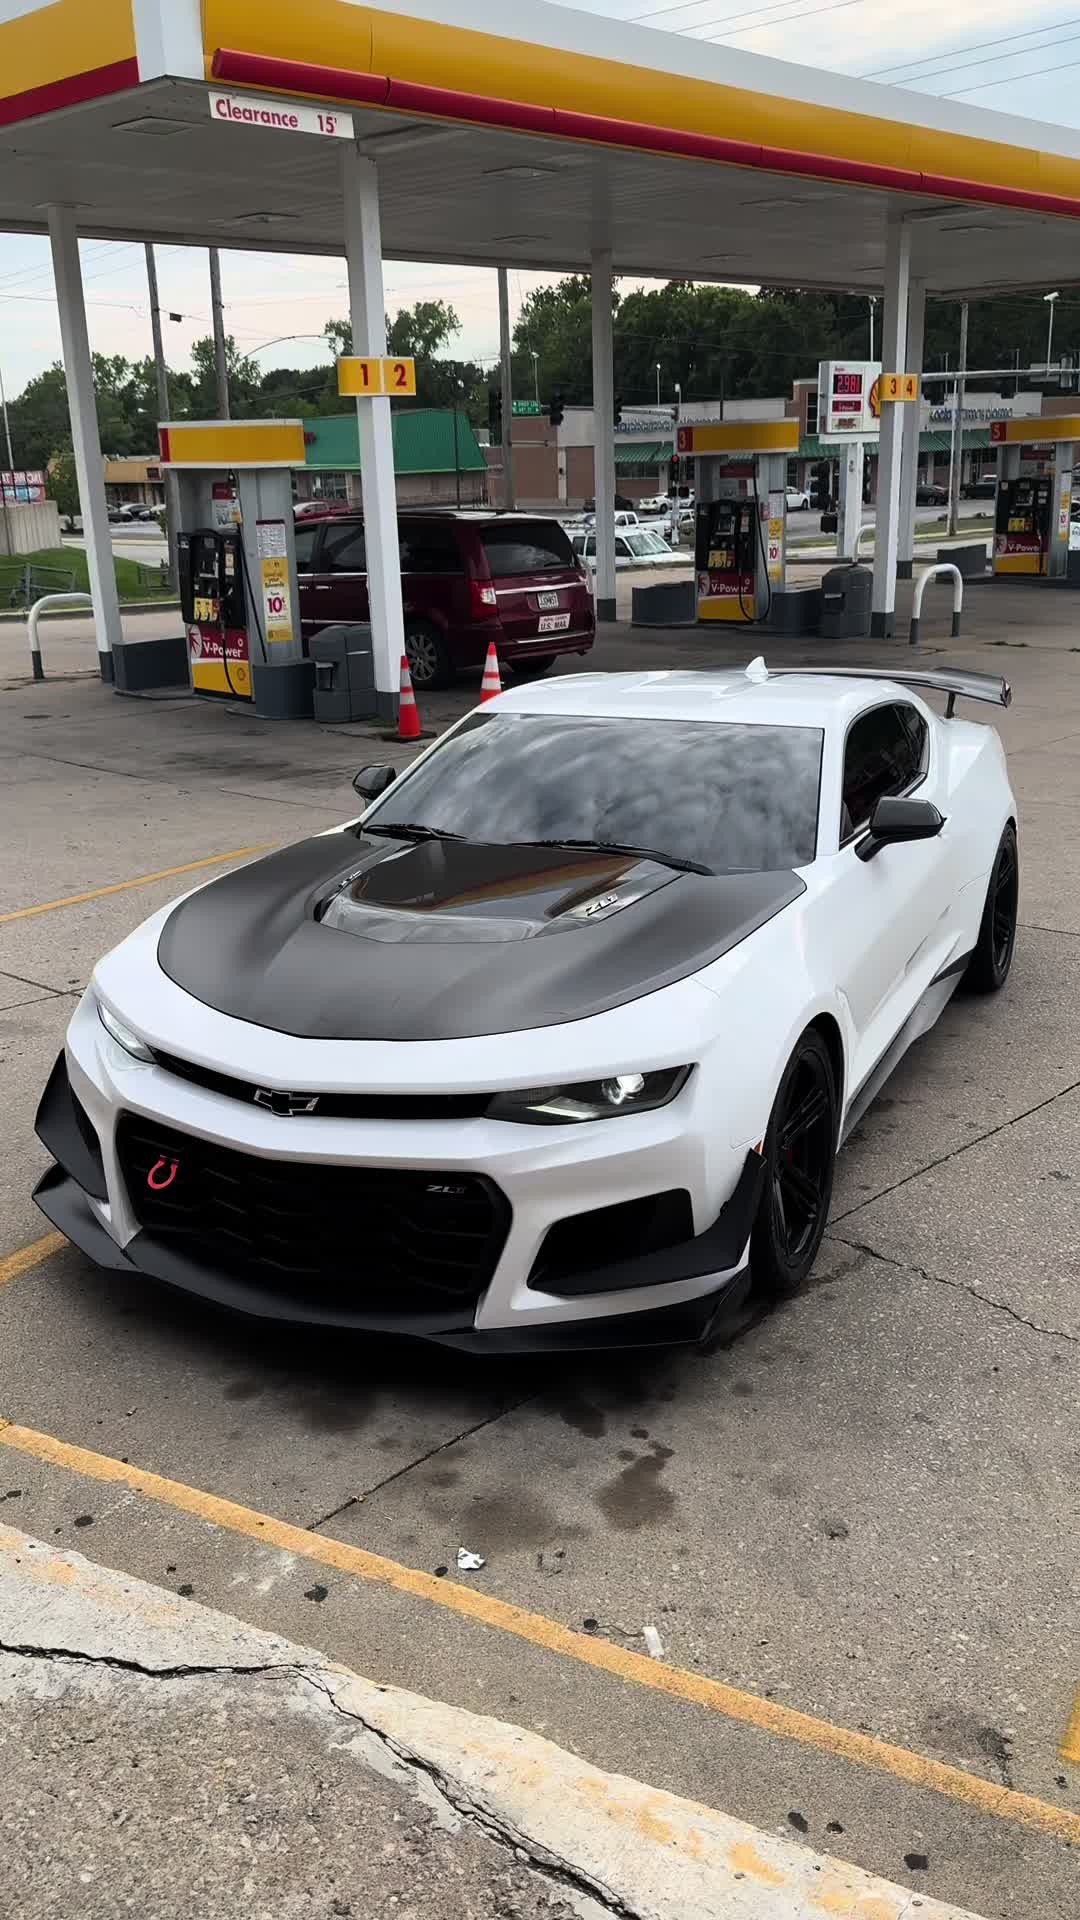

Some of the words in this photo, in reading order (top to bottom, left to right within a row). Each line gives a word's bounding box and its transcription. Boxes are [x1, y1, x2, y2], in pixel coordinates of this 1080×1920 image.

[216, 99, 298, 128] Clearance
[361, 364, 368, 386] 1
[394, 364, 407, 386] 2
[890, 378, 896, 395] 3
[906, 379, 913, 395] 4
[679, 431, 686, 449] 3
[203, 641, 243, 657] V-Power
